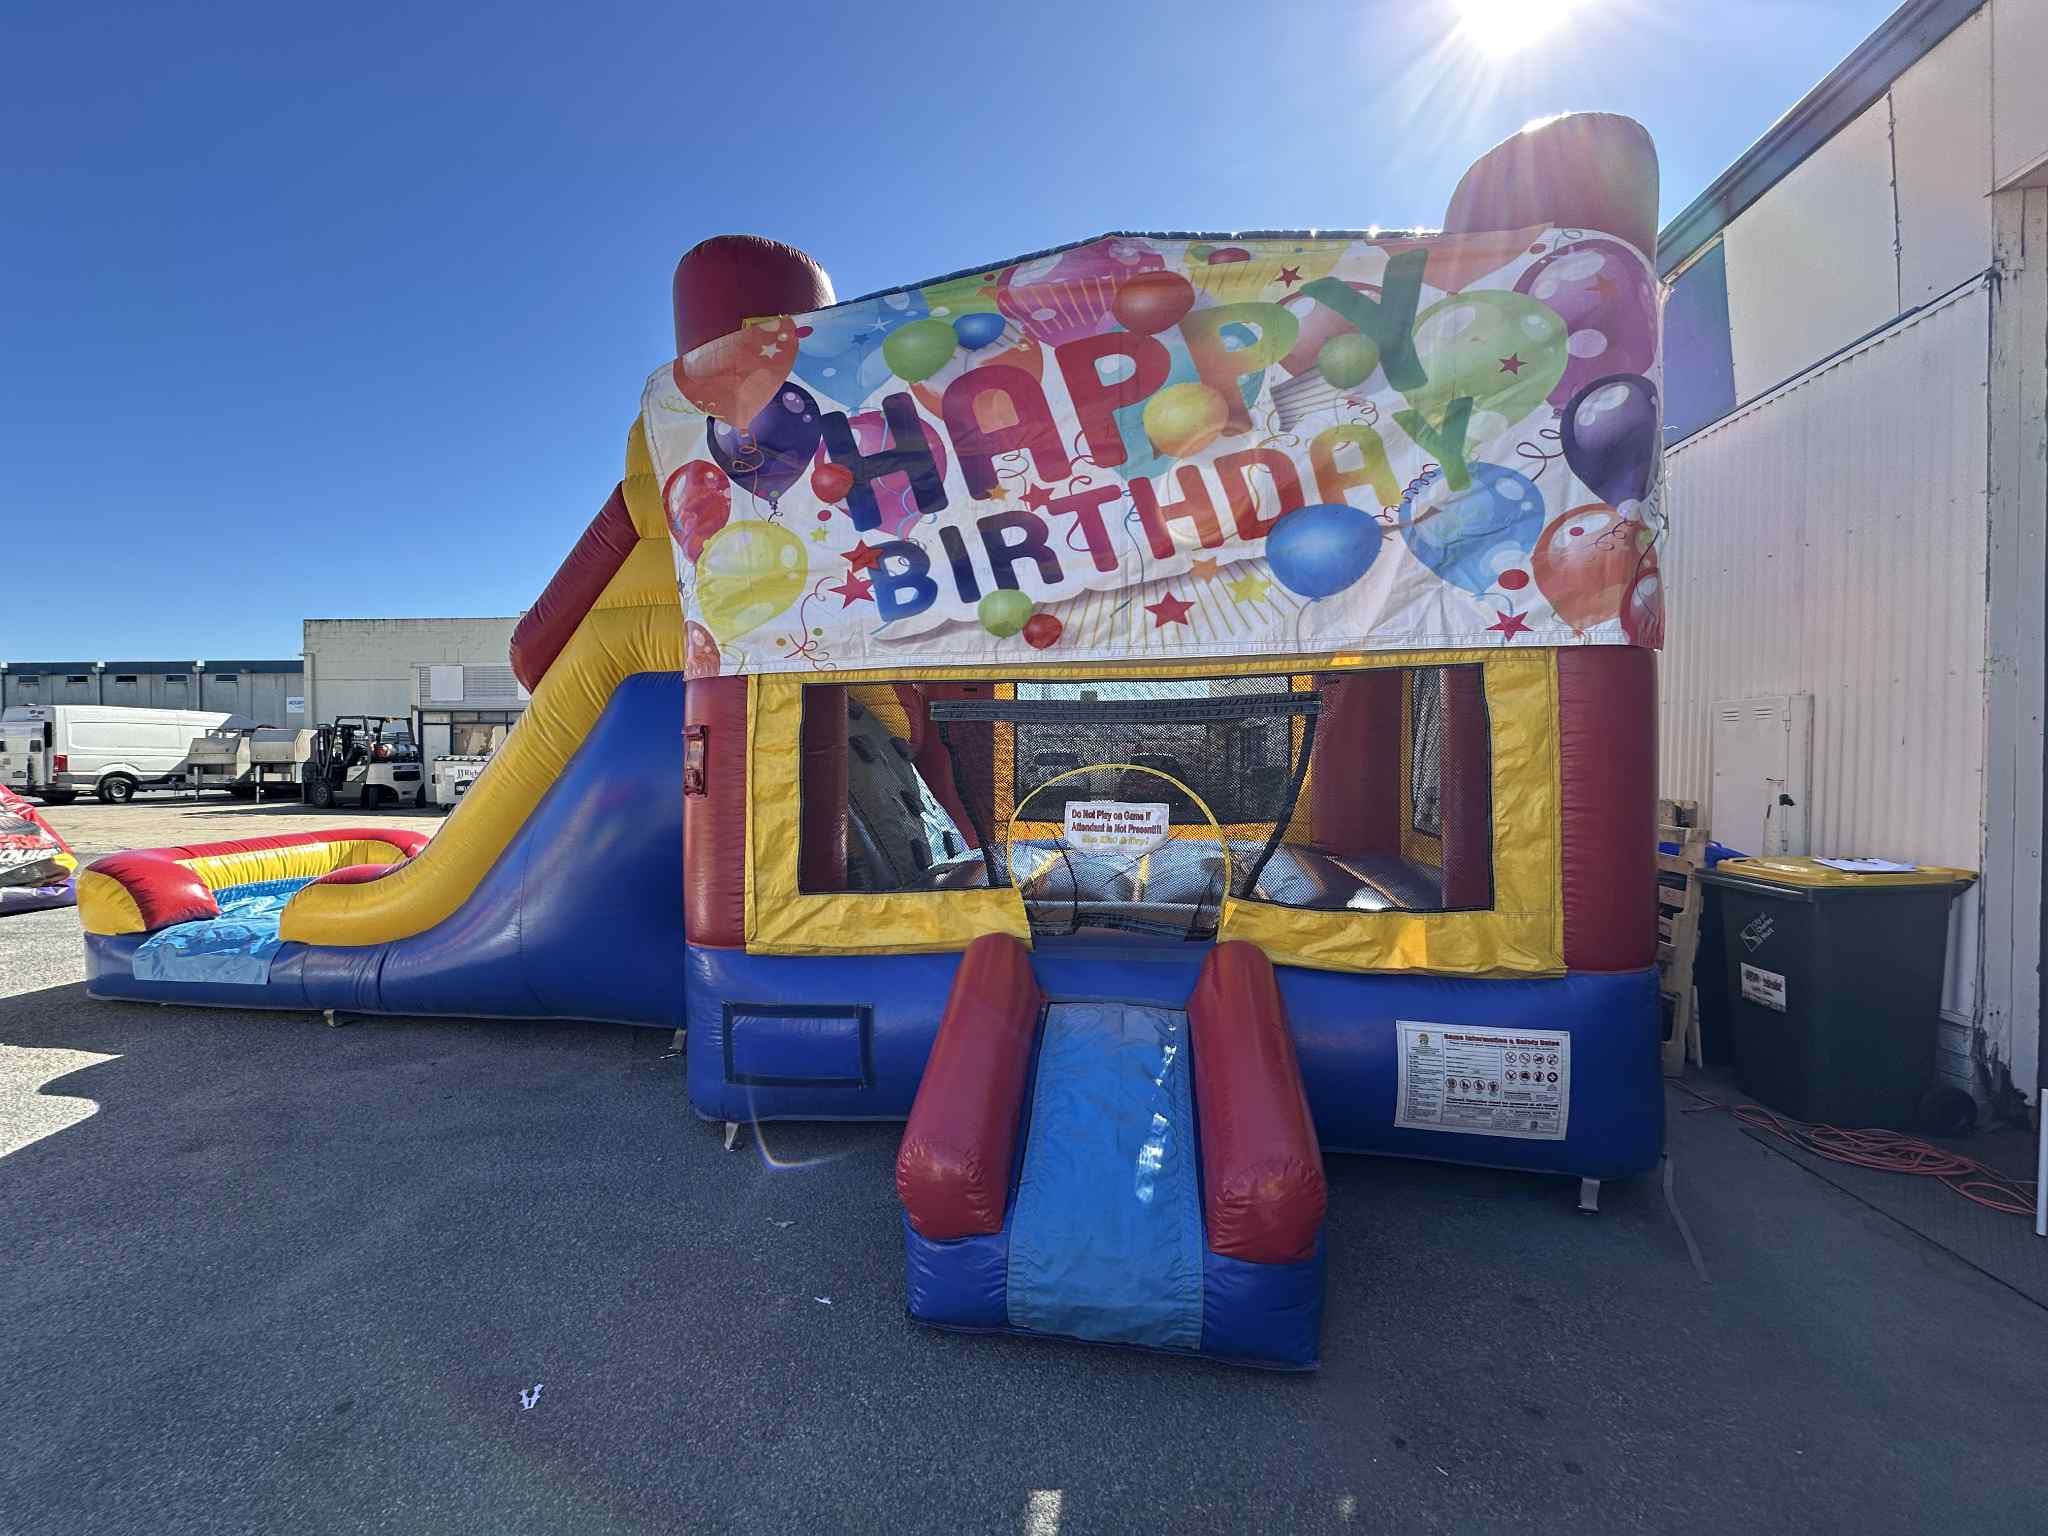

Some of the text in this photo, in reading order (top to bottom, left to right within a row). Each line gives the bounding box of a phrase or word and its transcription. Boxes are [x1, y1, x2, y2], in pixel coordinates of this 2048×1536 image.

[822, 248, 1430, 533] HAPPY
[872, 396, 1473, 623] BIRTHDAY
[1072, 809, 1081, 818] Do
[1083, 810, 1096, 819] Not
[1097, 810, 1113, 821] Play
[1124, 811, 1144, 820] Game
[1072, 822, 1105, 832] Attendant
[1106, 824, 1112, 832] is
[1114, 824, 1127, 833] Not
